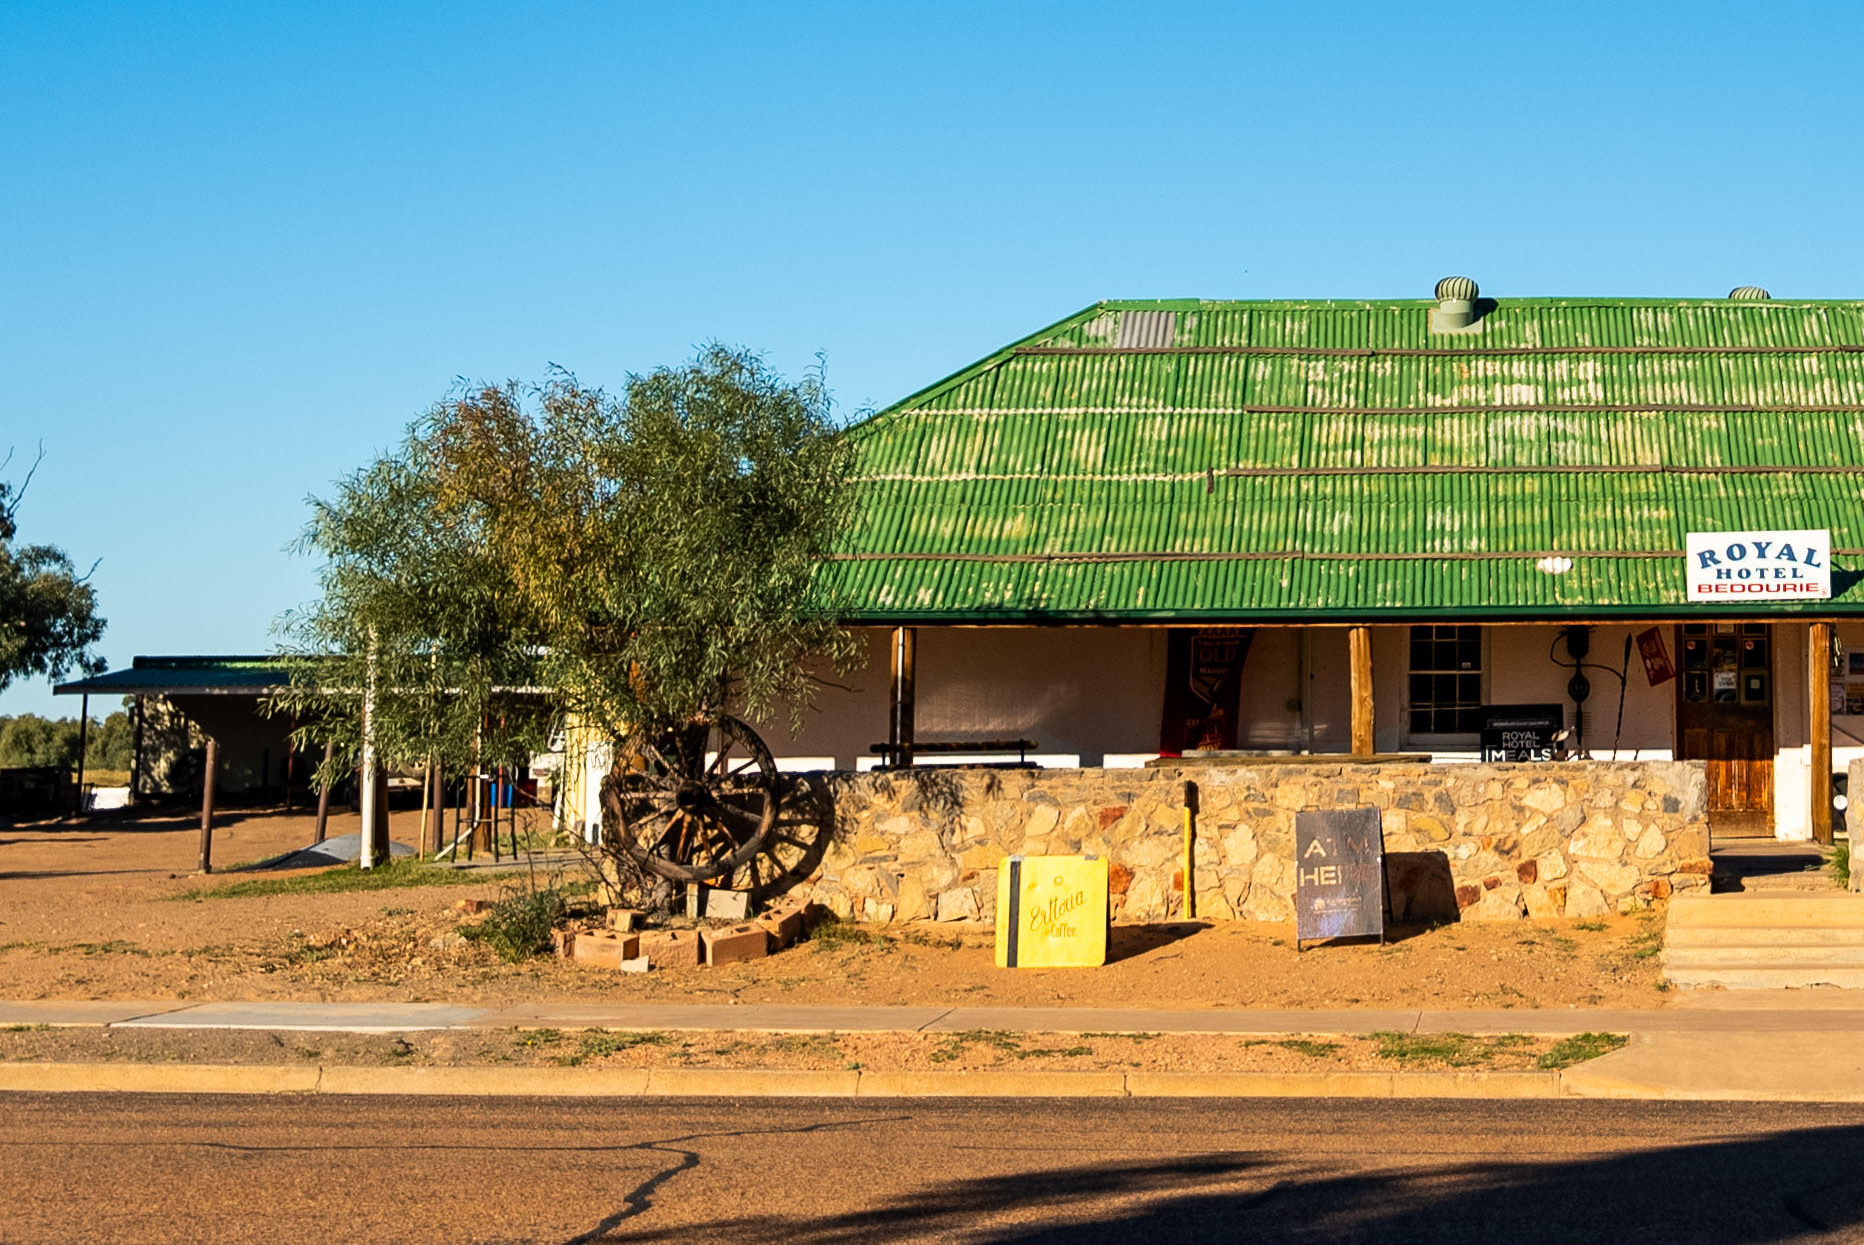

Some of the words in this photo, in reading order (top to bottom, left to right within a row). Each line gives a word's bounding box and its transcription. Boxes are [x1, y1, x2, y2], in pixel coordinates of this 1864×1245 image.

[1697, 542, 1821, 569] ROYAL
[1716, 568, 1803, 579] HOTEL
[1698, 583, 1818, 593] BEDOURIE
[1502, 731, 1540, 740] ROYAL
[1502, 740, 1540, 748] HOTEL
[1491, 748, 1551, 762] MEALS
[1050, 923, 1076, 938] Coffee
